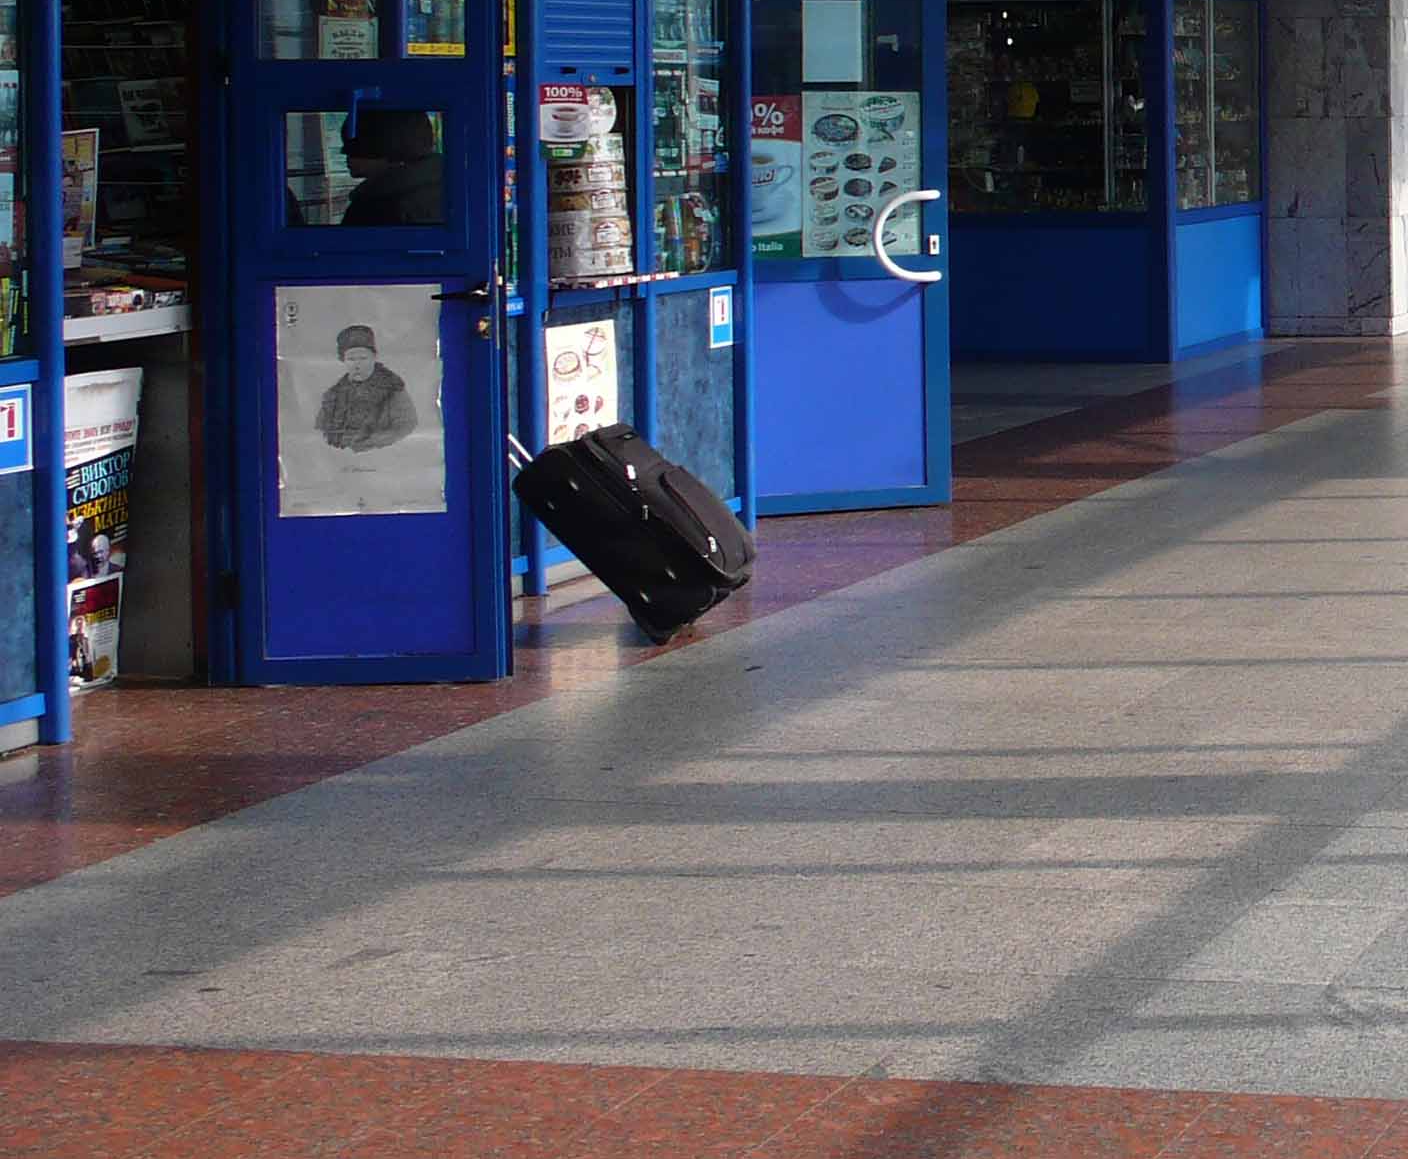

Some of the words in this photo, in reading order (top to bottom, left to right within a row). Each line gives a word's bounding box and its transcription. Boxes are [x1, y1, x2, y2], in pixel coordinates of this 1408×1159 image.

[544, 86, 583, 99] 100%
[757, 241, 784, 252] Italia
[80, 450, 130, 485] ВИКТОР
[72, 470, 128, 505] СУВОРОВ
